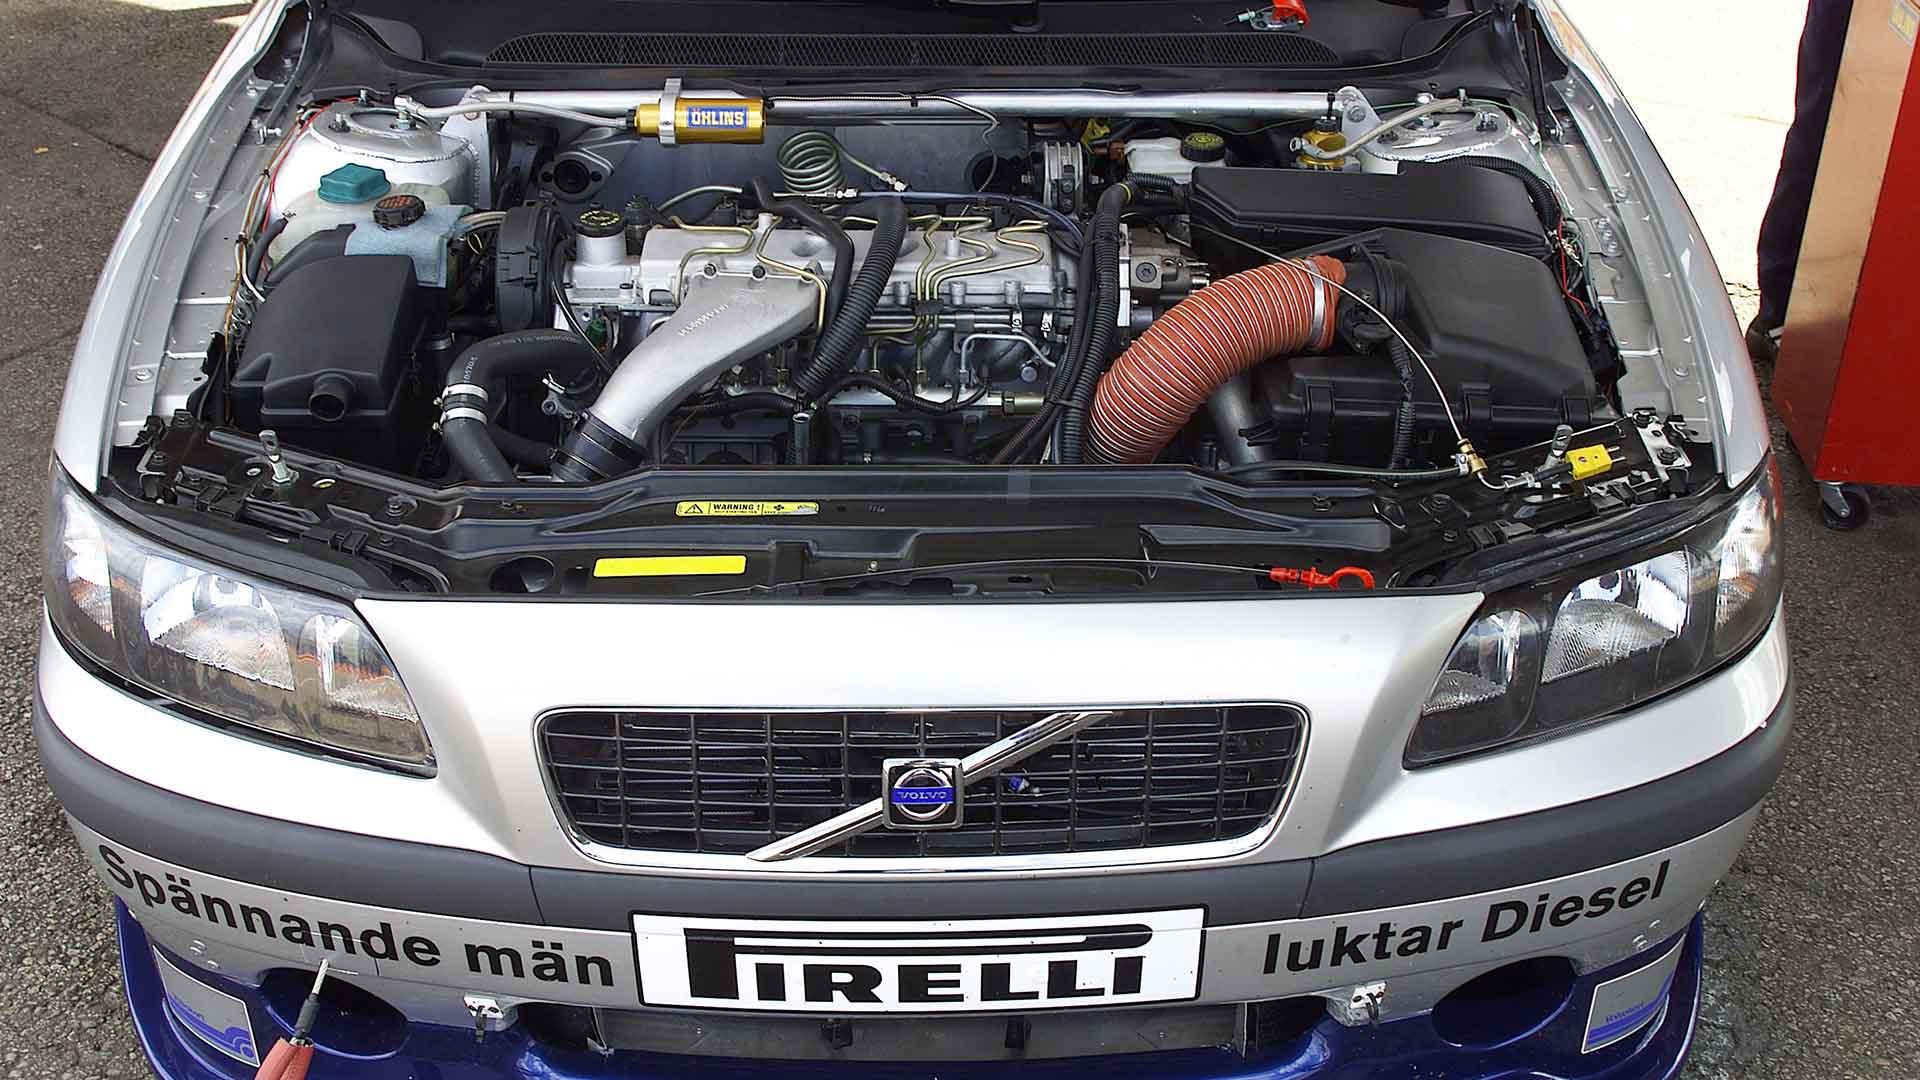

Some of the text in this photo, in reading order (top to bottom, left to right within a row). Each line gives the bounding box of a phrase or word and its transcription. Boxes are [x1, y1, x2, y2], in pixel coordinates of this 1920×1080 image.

[691, 108, 744, 126] ÖHLINS
[713, 503, 755, 511] WARNING
[897, 791, 947, 800] VOLVO
[99, 844, 614, 987] Spännande män
[1262, 859, 1671, 975] luktar Diesel
[683, 923, 1153, 1003] PIRELLI
